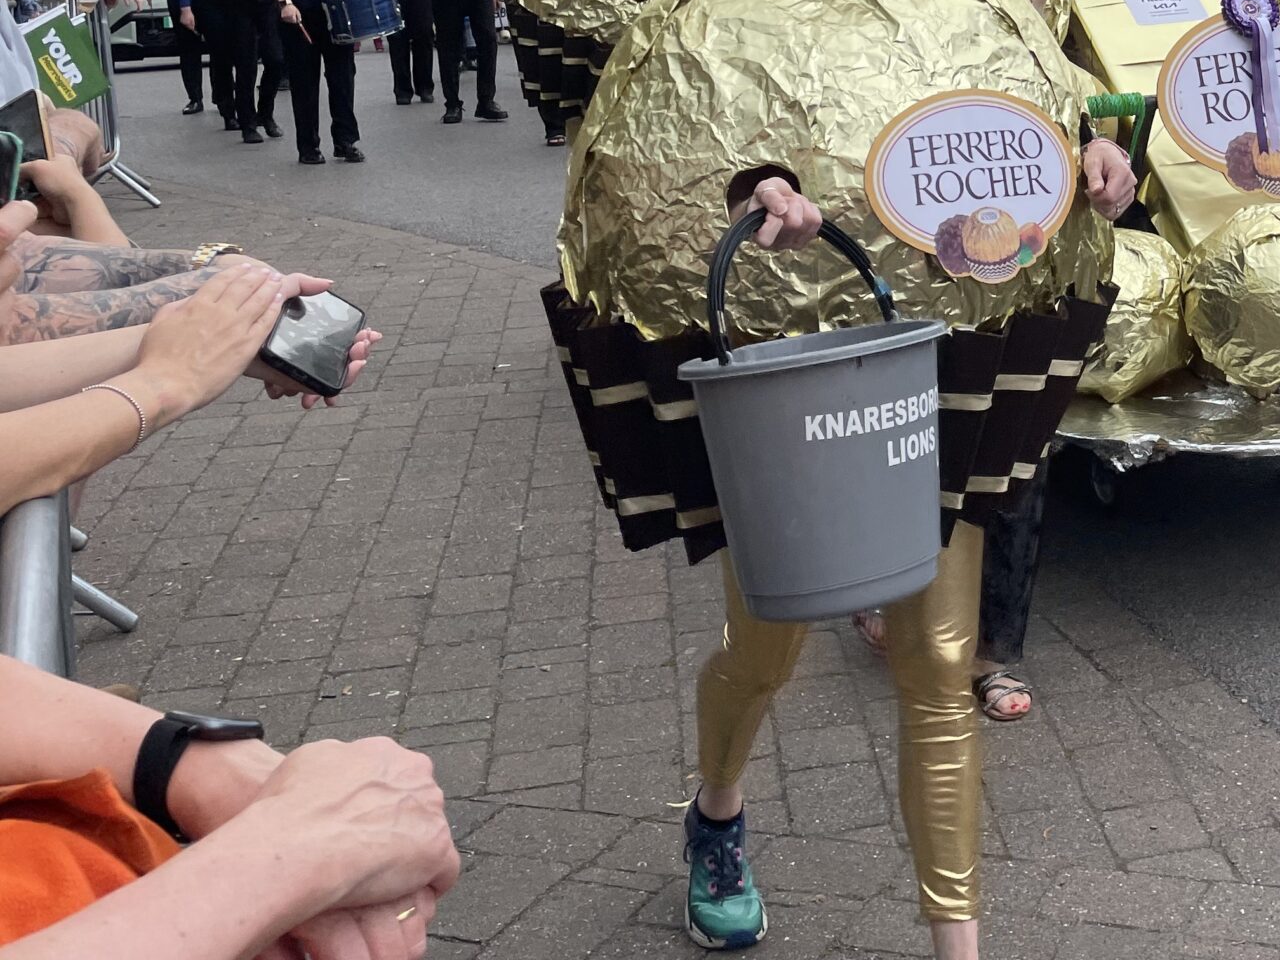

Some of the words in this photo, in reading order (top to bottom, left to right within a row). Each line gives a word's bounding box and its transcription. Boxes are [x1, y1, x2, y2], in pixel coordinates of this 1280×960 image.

[41, 27, 83, 87] YOUR
[906, 128, 1043, 169] FERRERO
[911, 164, 1052, 206] ROCHER
[887, 426, 936, 467] LIONS
